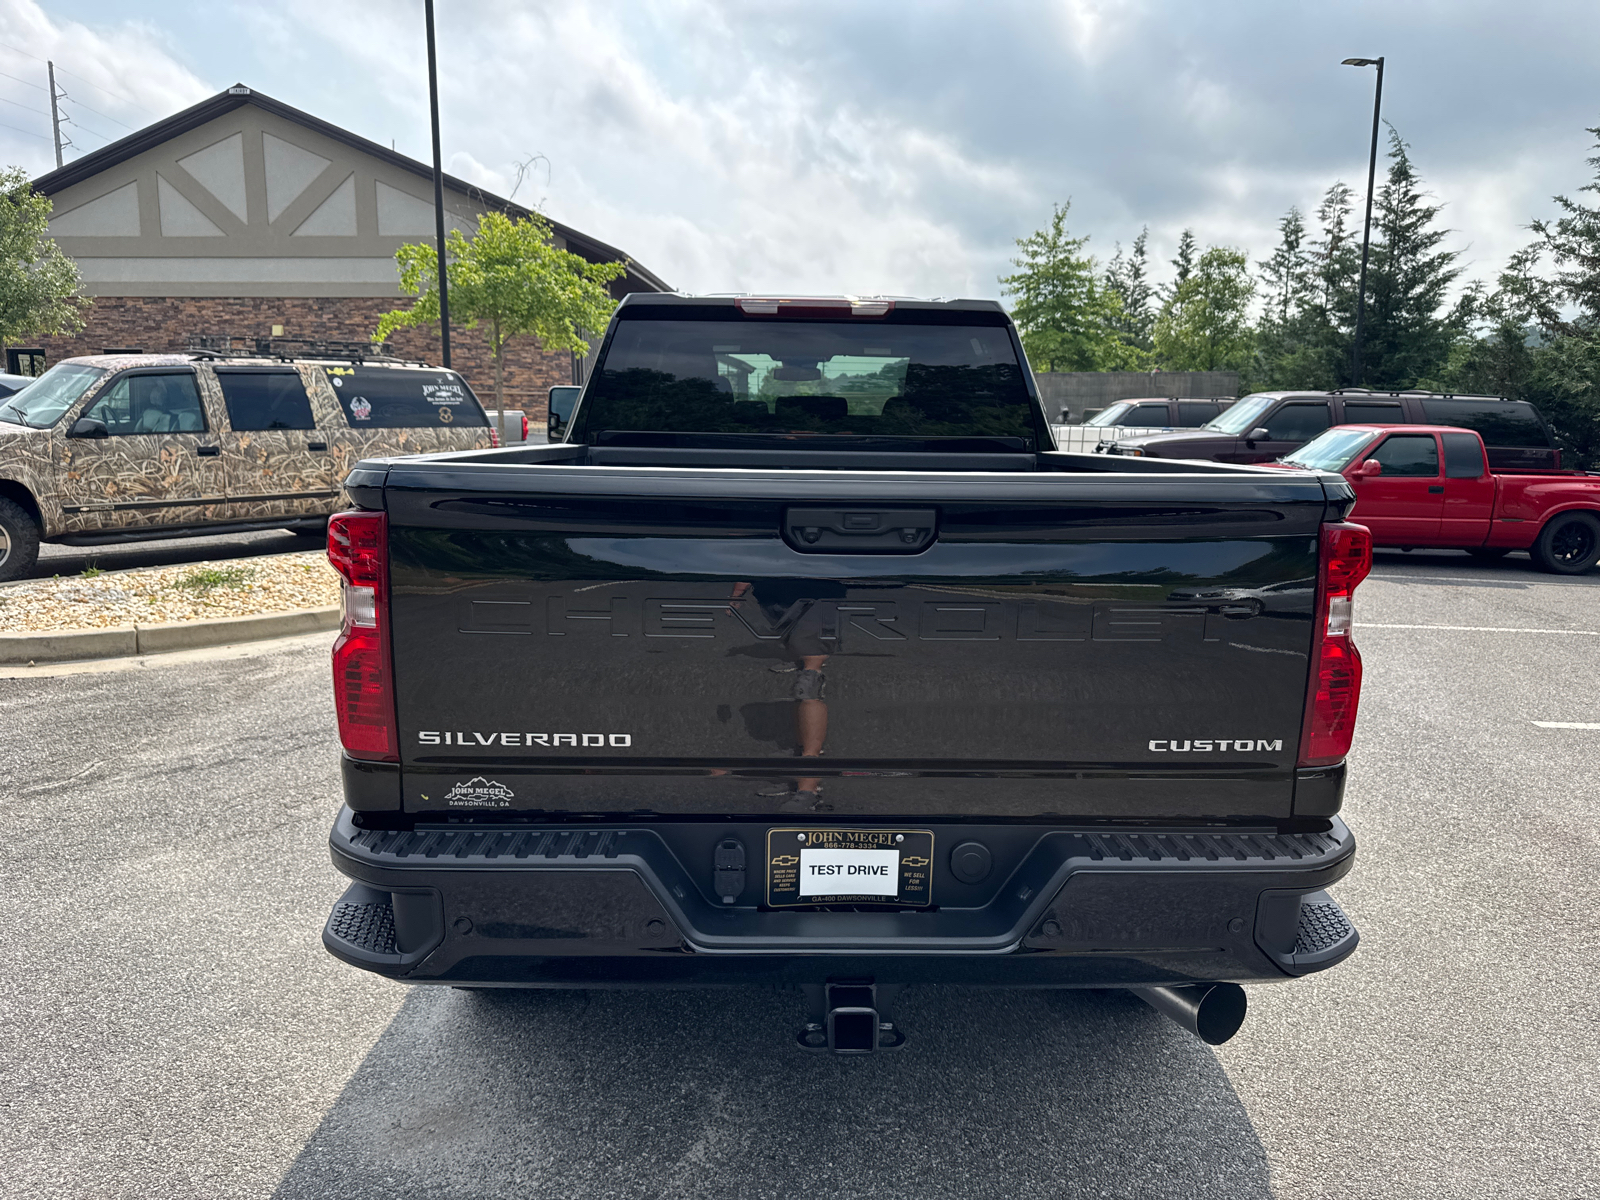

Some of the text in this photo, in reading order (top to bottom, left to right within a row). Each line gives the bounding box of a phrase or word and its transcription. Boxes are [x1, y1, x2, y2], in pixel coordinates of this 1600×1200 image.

[456, 595, 1257, 643] CHEVROLET
[418, 730, 632, 748] SILVERADO
[1148, 738, 1283, 753] CUSTOM
[451, 787, 506, 796] JOHN MEGEL
[806, 832, 897, 846] JOHN MEGEL
[809, 865, 889, 876] TEST DRIVE
